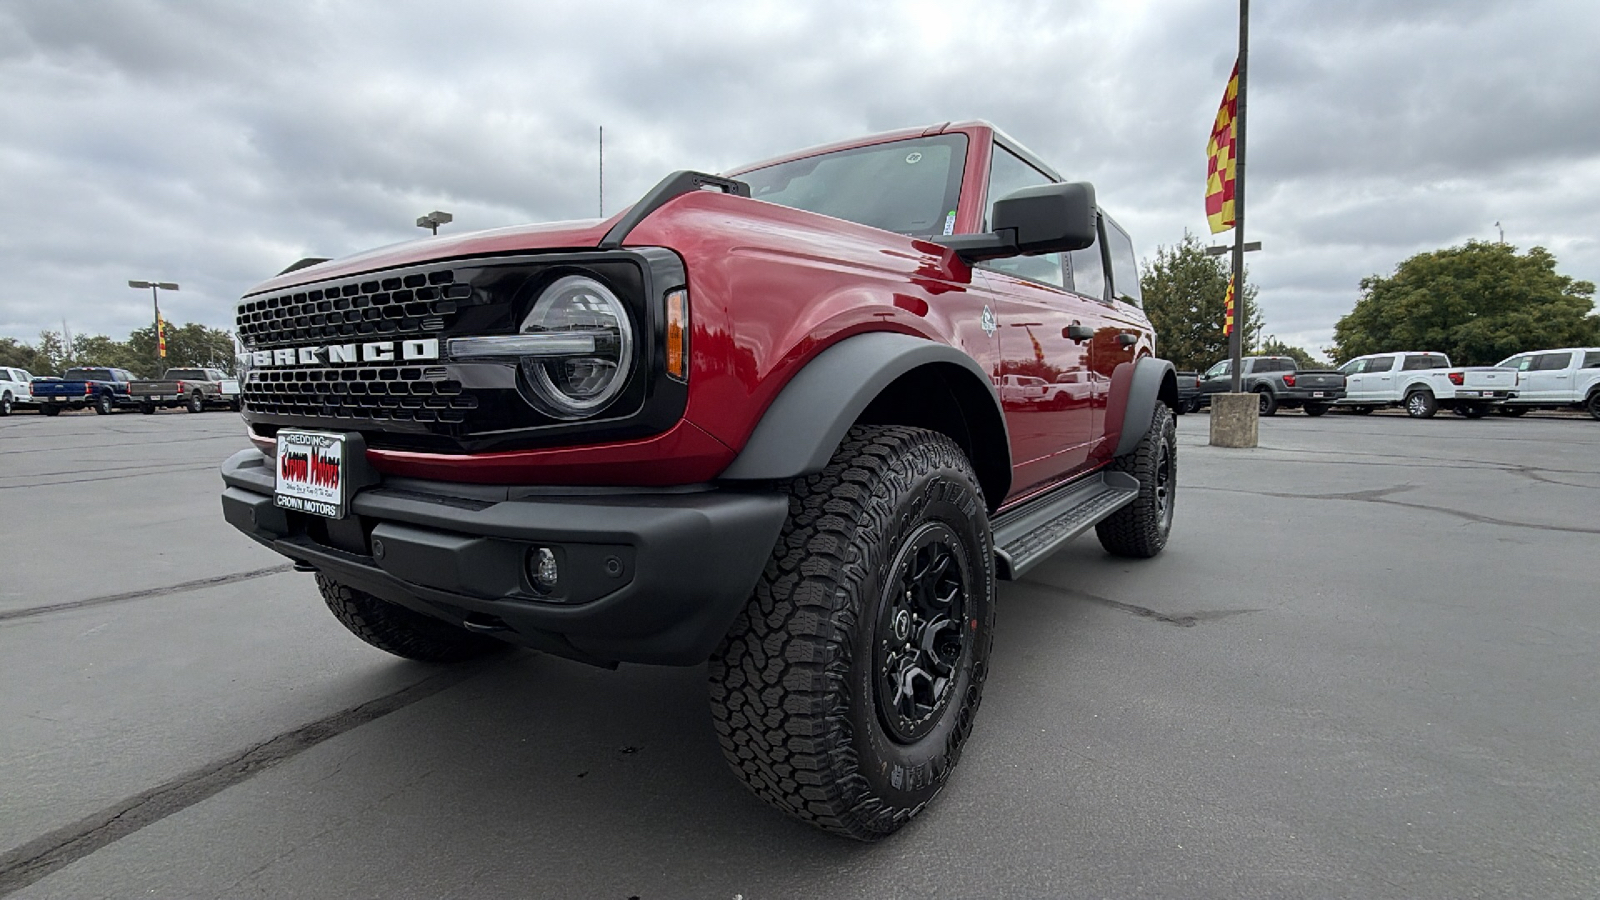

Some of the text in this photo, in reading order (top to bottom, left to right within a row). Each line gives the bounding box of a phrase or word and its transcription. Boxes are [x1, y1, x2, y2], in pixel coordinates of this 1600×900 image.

[252, 338, 440, 366] BRONCO
[290, 434, 325, 446] REDDING
[281, 446, 340, 490] Crown Motors
[277, 494, 336, 516] CROWN MOTORS
